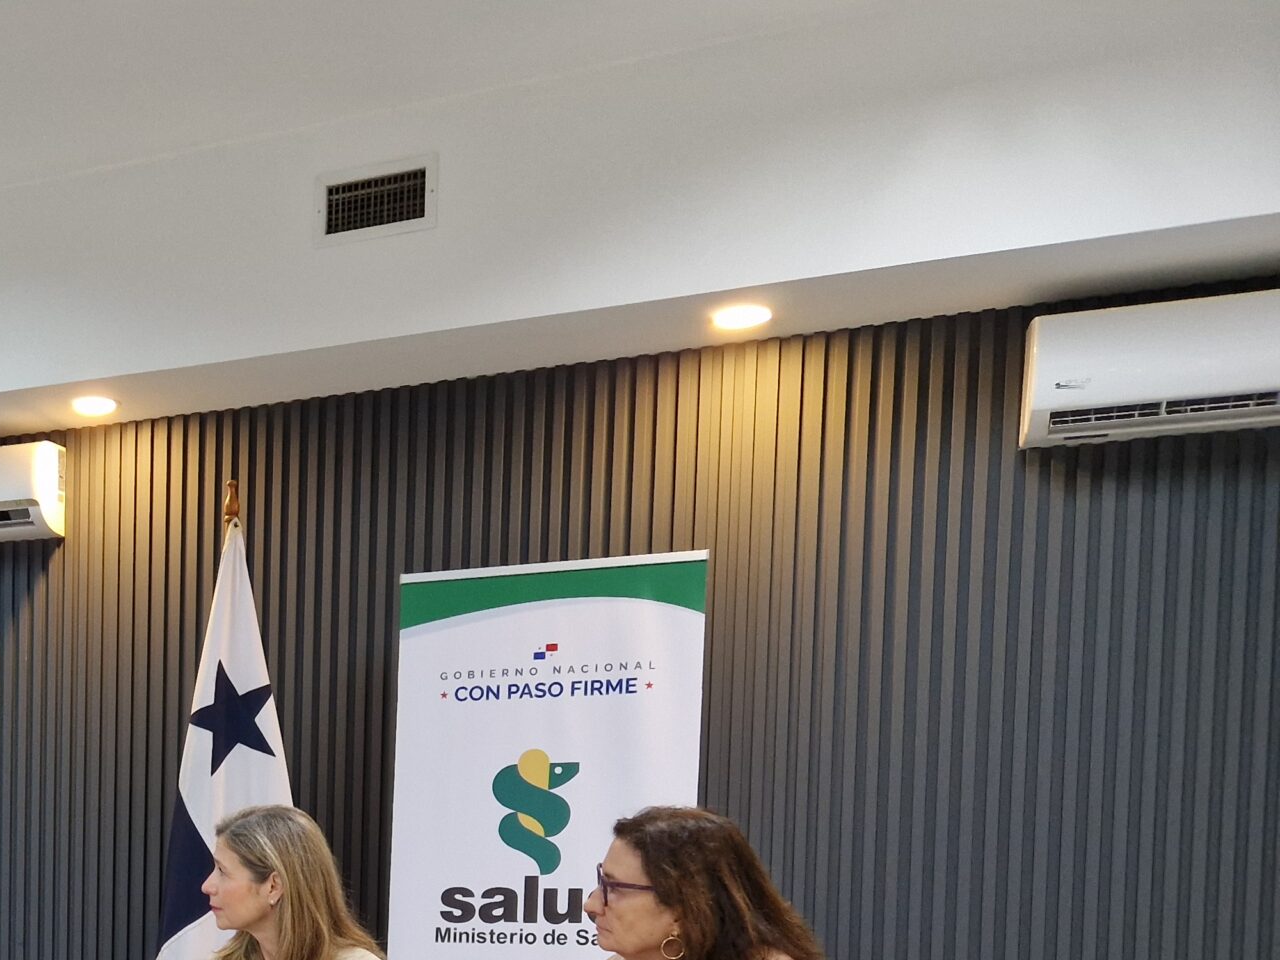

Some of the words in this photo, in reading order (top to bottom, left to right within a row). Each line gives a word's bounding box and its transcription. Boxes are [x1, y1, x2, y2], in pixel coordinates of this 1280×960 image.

[440, 666, 539, 681] GOBIERNO
[552, 660, 656, 675] NACIONAL
[454, 684, 501, 702] CON
[507, 681, 564, 700] PASO
[570, 677, 638, 697] FIRME
[439, 875, 597, 925] salu
[434, 927, 537, 945] Ministerio
[543, 928, 568, 946] de
[575, 928, 599, 946] Sa
